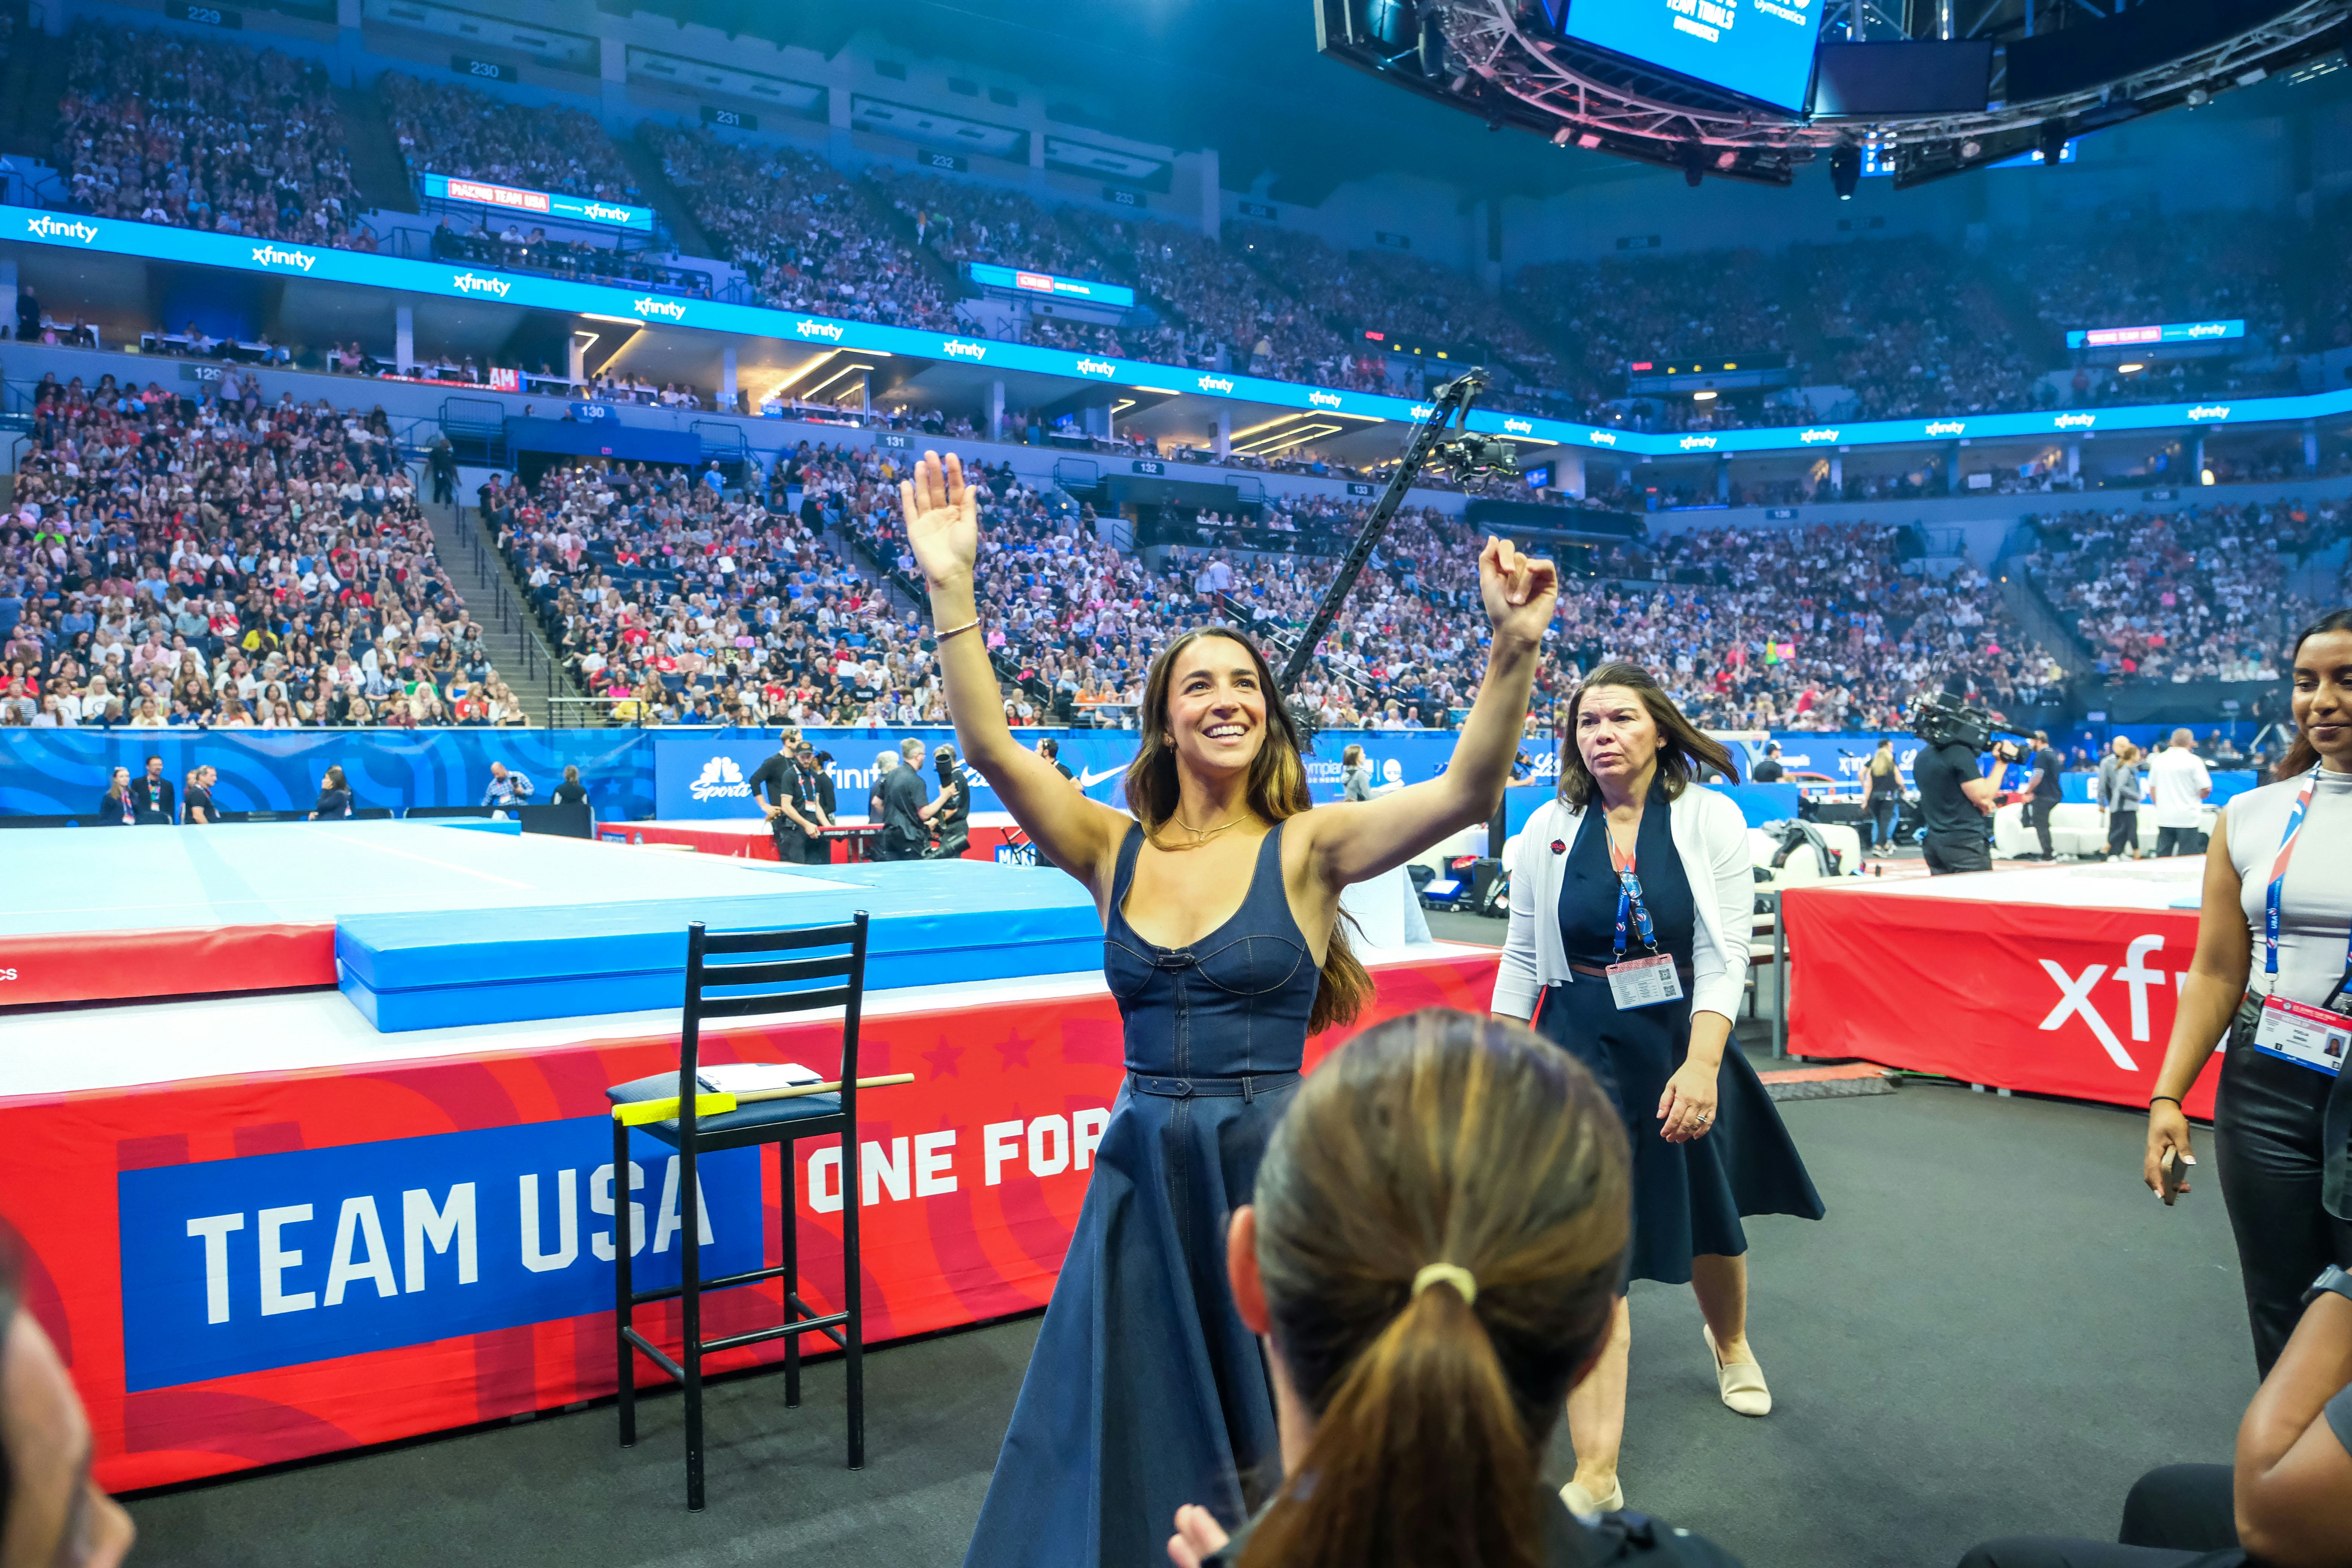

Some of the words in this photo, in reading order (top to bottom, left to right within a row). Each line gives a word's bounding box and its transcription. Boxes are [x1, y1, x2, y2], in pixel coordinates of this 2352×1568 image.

[188, 6, 221, 24] 229
[471, 61, 499, 77] 230
[717, 110, 739, 125] 231
[932, 154, 954, 169] 232
[495, 189, 522, 205] TEAM
[524, 195, 546, 209] USA
[1115, 191, 1134, 205] 233
[584, 204, 630, 222] xfinity
[28, 216, 98, 243] xfinity
[252, 245, 315, 271] xfinity
[454, 273, 511, 297] xfinity
[634, 297, 686, 320] xfinity
[797, 319, 844, 341] xfinity
[2188, 325, 2226, 337] xfinity
[943, 340, 986, 360] xfinity
[1077, 358, 1116, 378] xfinity
[1198, 375, 1234, 394] xfinity
[1309, 390, 1342, 409] xfinity
[582, 406, 604, 418] 130
[1411, 405, 1435, 419] xfin
[2188, 406, 2230, 421] xfinity
[1504, 418, 1532, 434] xfinity
[1926, 422, 1965, 436] xfinity
[2055, 413, 2096, 429] xfinity
[886, 436, 904, 447] 131
[1590, 430, 1616, 446] xfinity
[1680, 436, 1717, 450] xfinity
[1801, 429, 1839, 443] xfinity
[1140, 462, 1156, 473] 132
[1354, 485, 1368, 495] 133
[825, 761, 881, 789] finit
[689, 779, 752, 803] Sports
[187, 1182, 479, 1325] TEAM
[520, 1155, 715, 1275] USA
[808, 1130, 958, 1214] ONE
[983, 1107, 1111, 1186] FOR
